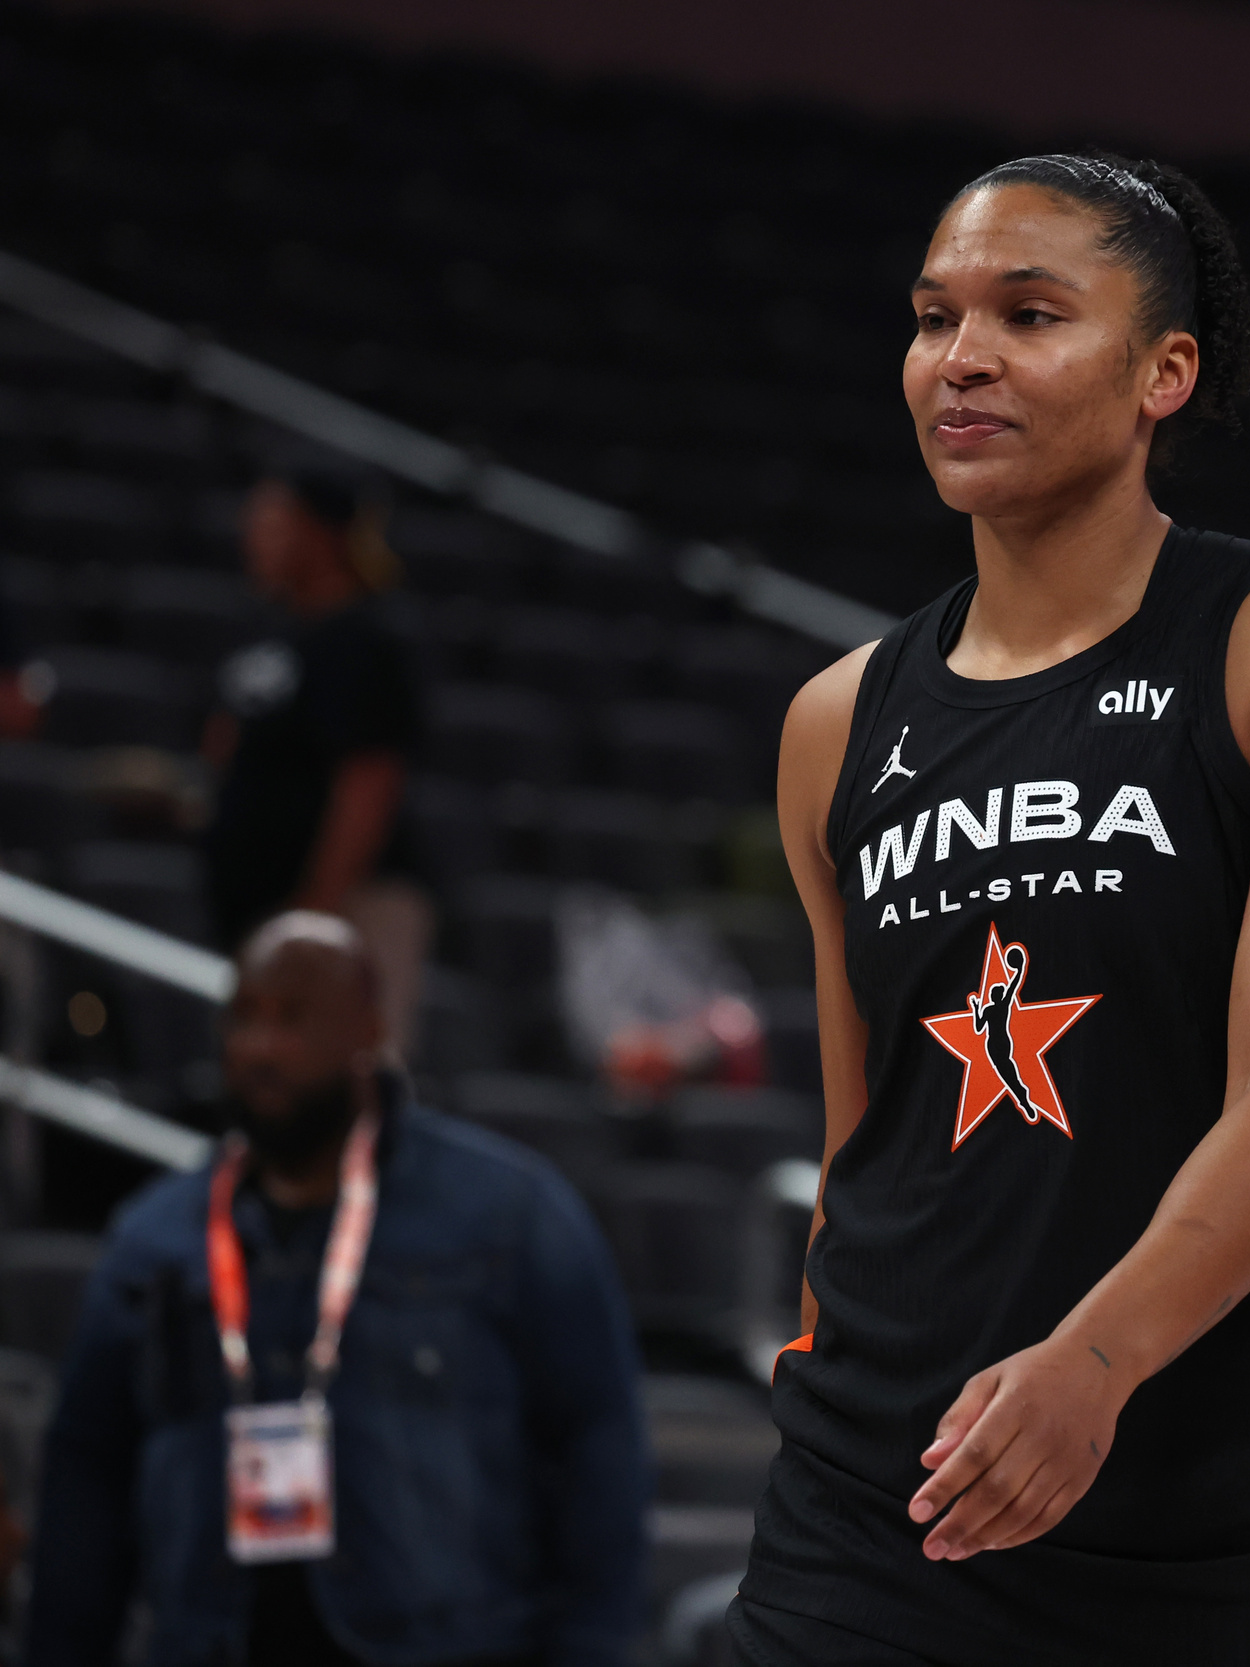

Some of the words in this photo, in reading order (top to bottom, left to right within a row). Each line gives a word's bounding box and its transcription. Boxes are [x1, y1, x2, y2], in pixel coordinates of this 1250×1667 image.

[1098, 679, 1175, 721] ally
[859, 780, 1177, 901] WNBA
[878, 869, 1123, 930] ALL-STAR
